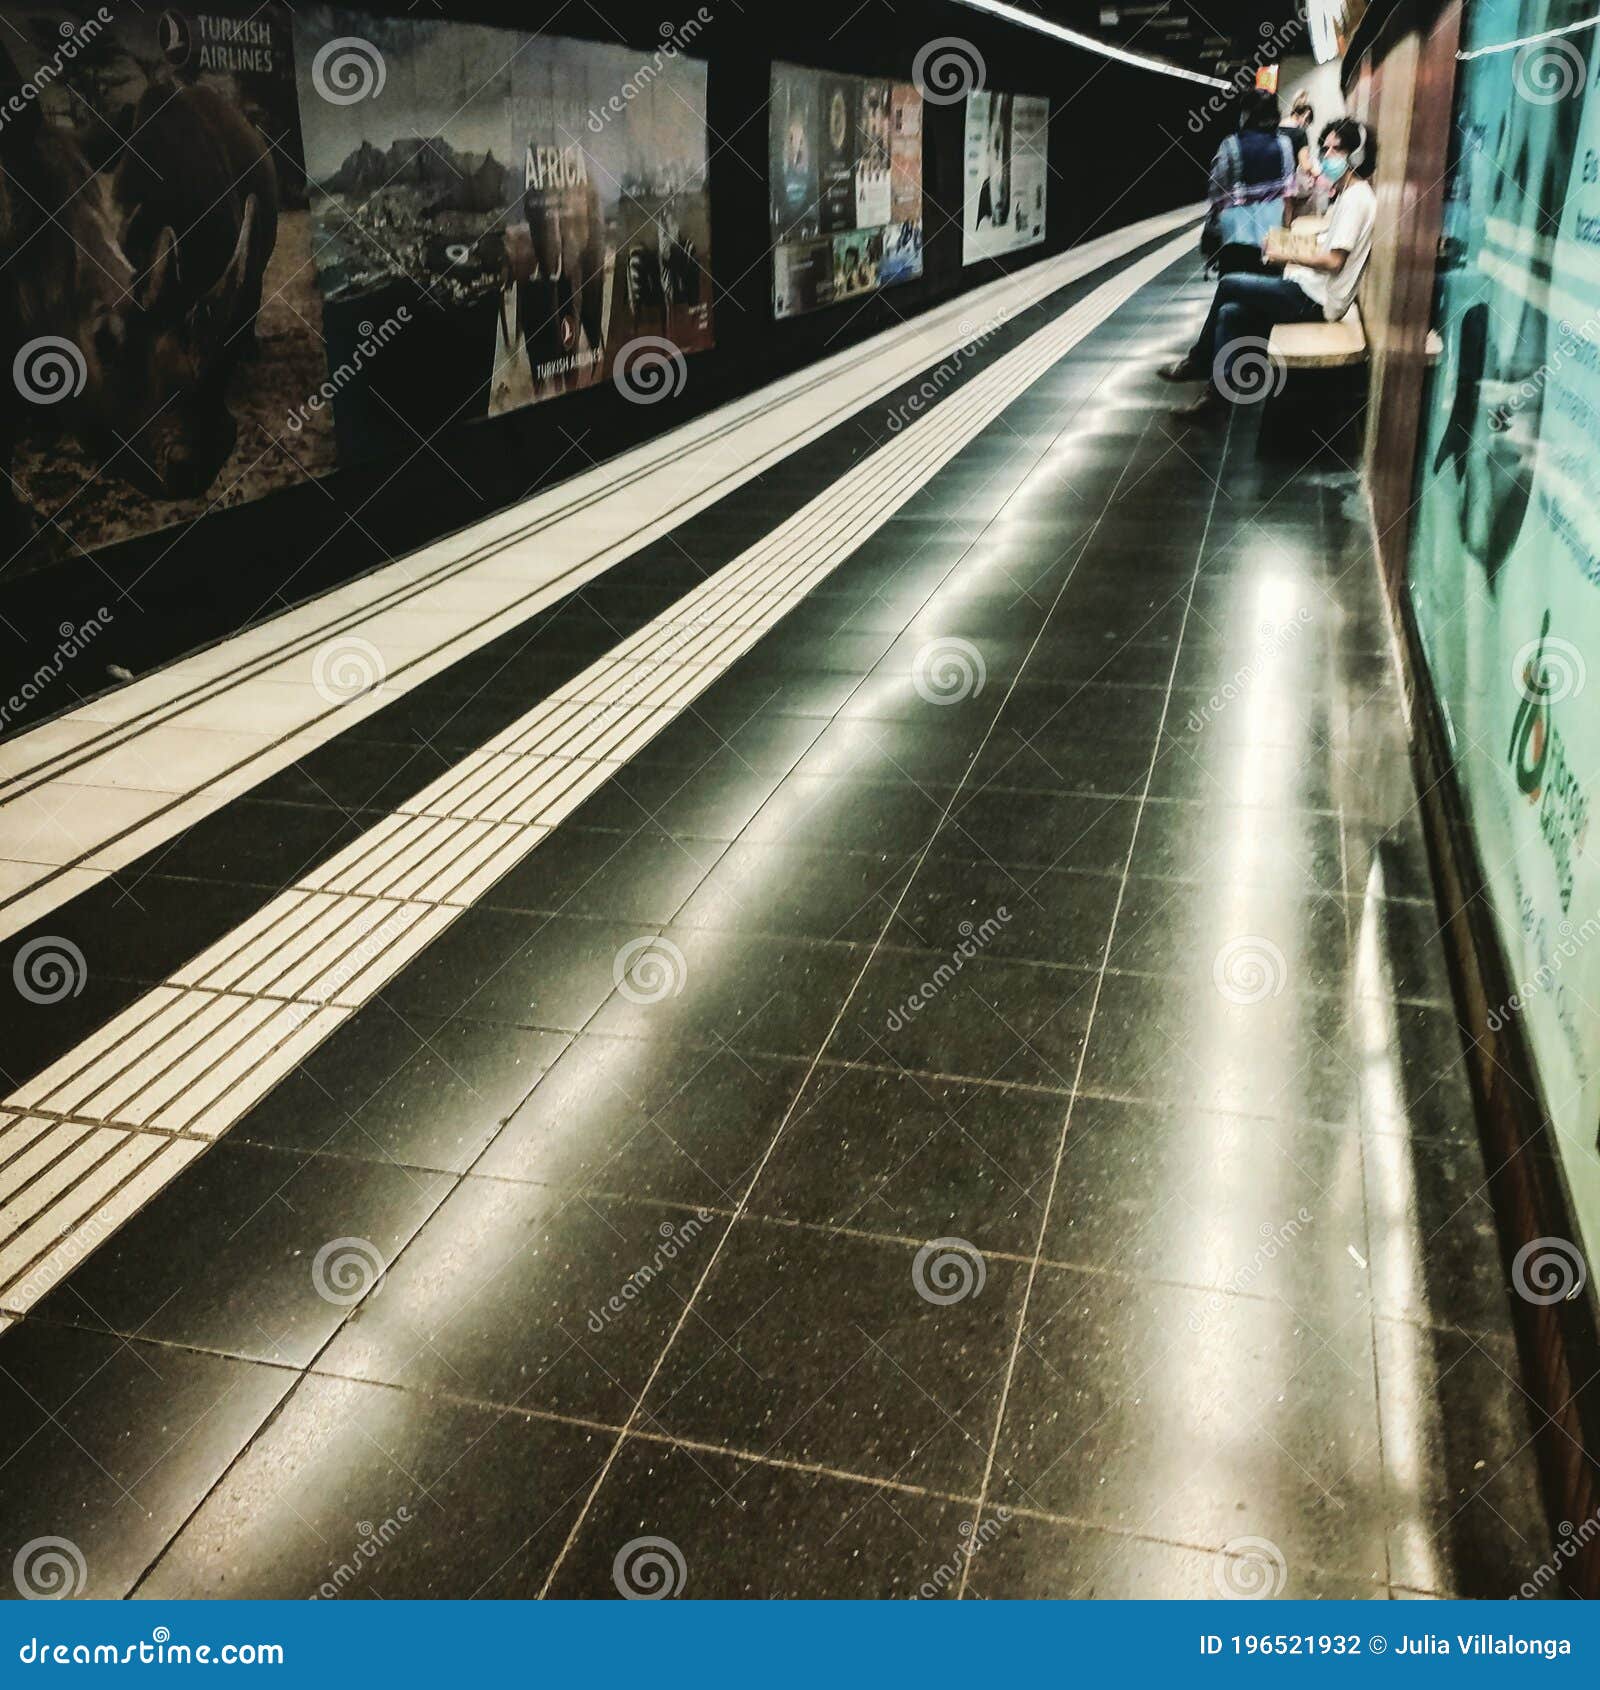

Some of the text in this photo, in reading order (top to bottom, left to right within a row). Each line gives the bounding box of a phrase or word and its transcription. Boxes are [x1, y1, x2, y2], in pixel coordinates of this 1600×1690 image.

[198, 15, 271, 45] TURKISH
[200, 45, 273, 72] AIRLINES
[525, 146, 588, 191] AFRICA
[537, 356, 569, 379] TURKISH
